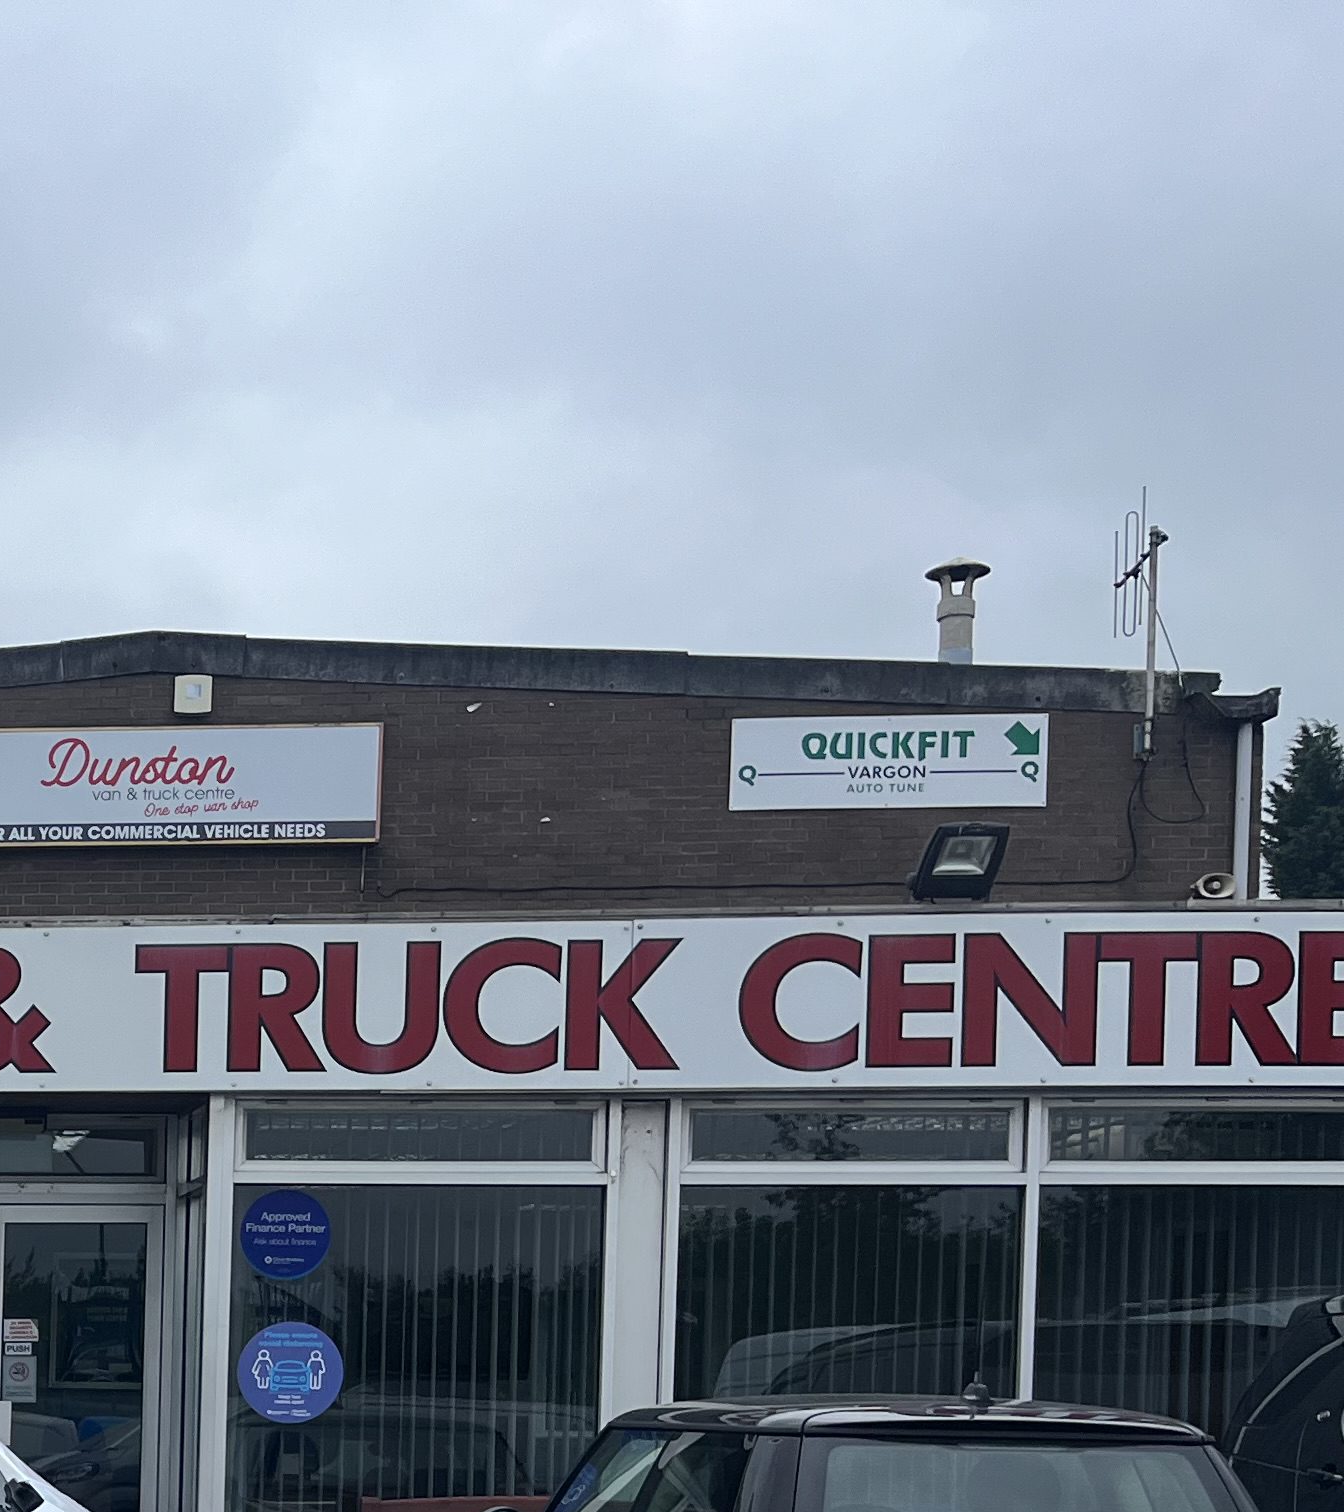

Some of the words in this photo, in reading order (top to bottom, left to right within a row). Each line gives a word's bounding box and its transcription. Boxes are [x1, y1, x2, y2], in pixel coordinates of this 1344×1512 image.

[801, 731, 975, 761] QUICKFIT
[40, 738, 235, 787] Dunston
[847, 766, 927, 779] VARGON
[92, 788, 121, 801] van
[126, 788, 137, 800] &
[143, 787, 179, 800] truck
[184, 787, 235, 800] centre
[846, 782, 884, 793] AUTO
[889, 782, 925, 793] TUNE
[144, 802, 170, 817] One
[175, 801, 198, 817] stop
[203, 802, 227, 813] van
[231, 798, 259, 812] shop
[9, 827, 36, 841] ALL
[39, 826, 83, 840] YOUR
[87, 825, 200, 840] COMMERCIAL
[203, 824, 270, 839] VEHICLE
[274, 823, 326, 838] NEEDS
[134, 937, 683, 1074] TRUCK
[260, 1212, 311, 1223] Approved
[245, 1222, 286, 1233] Finance
[288, 1223, 326, 1233] Partner
[6, 1345, 30, 1353] PUSH
